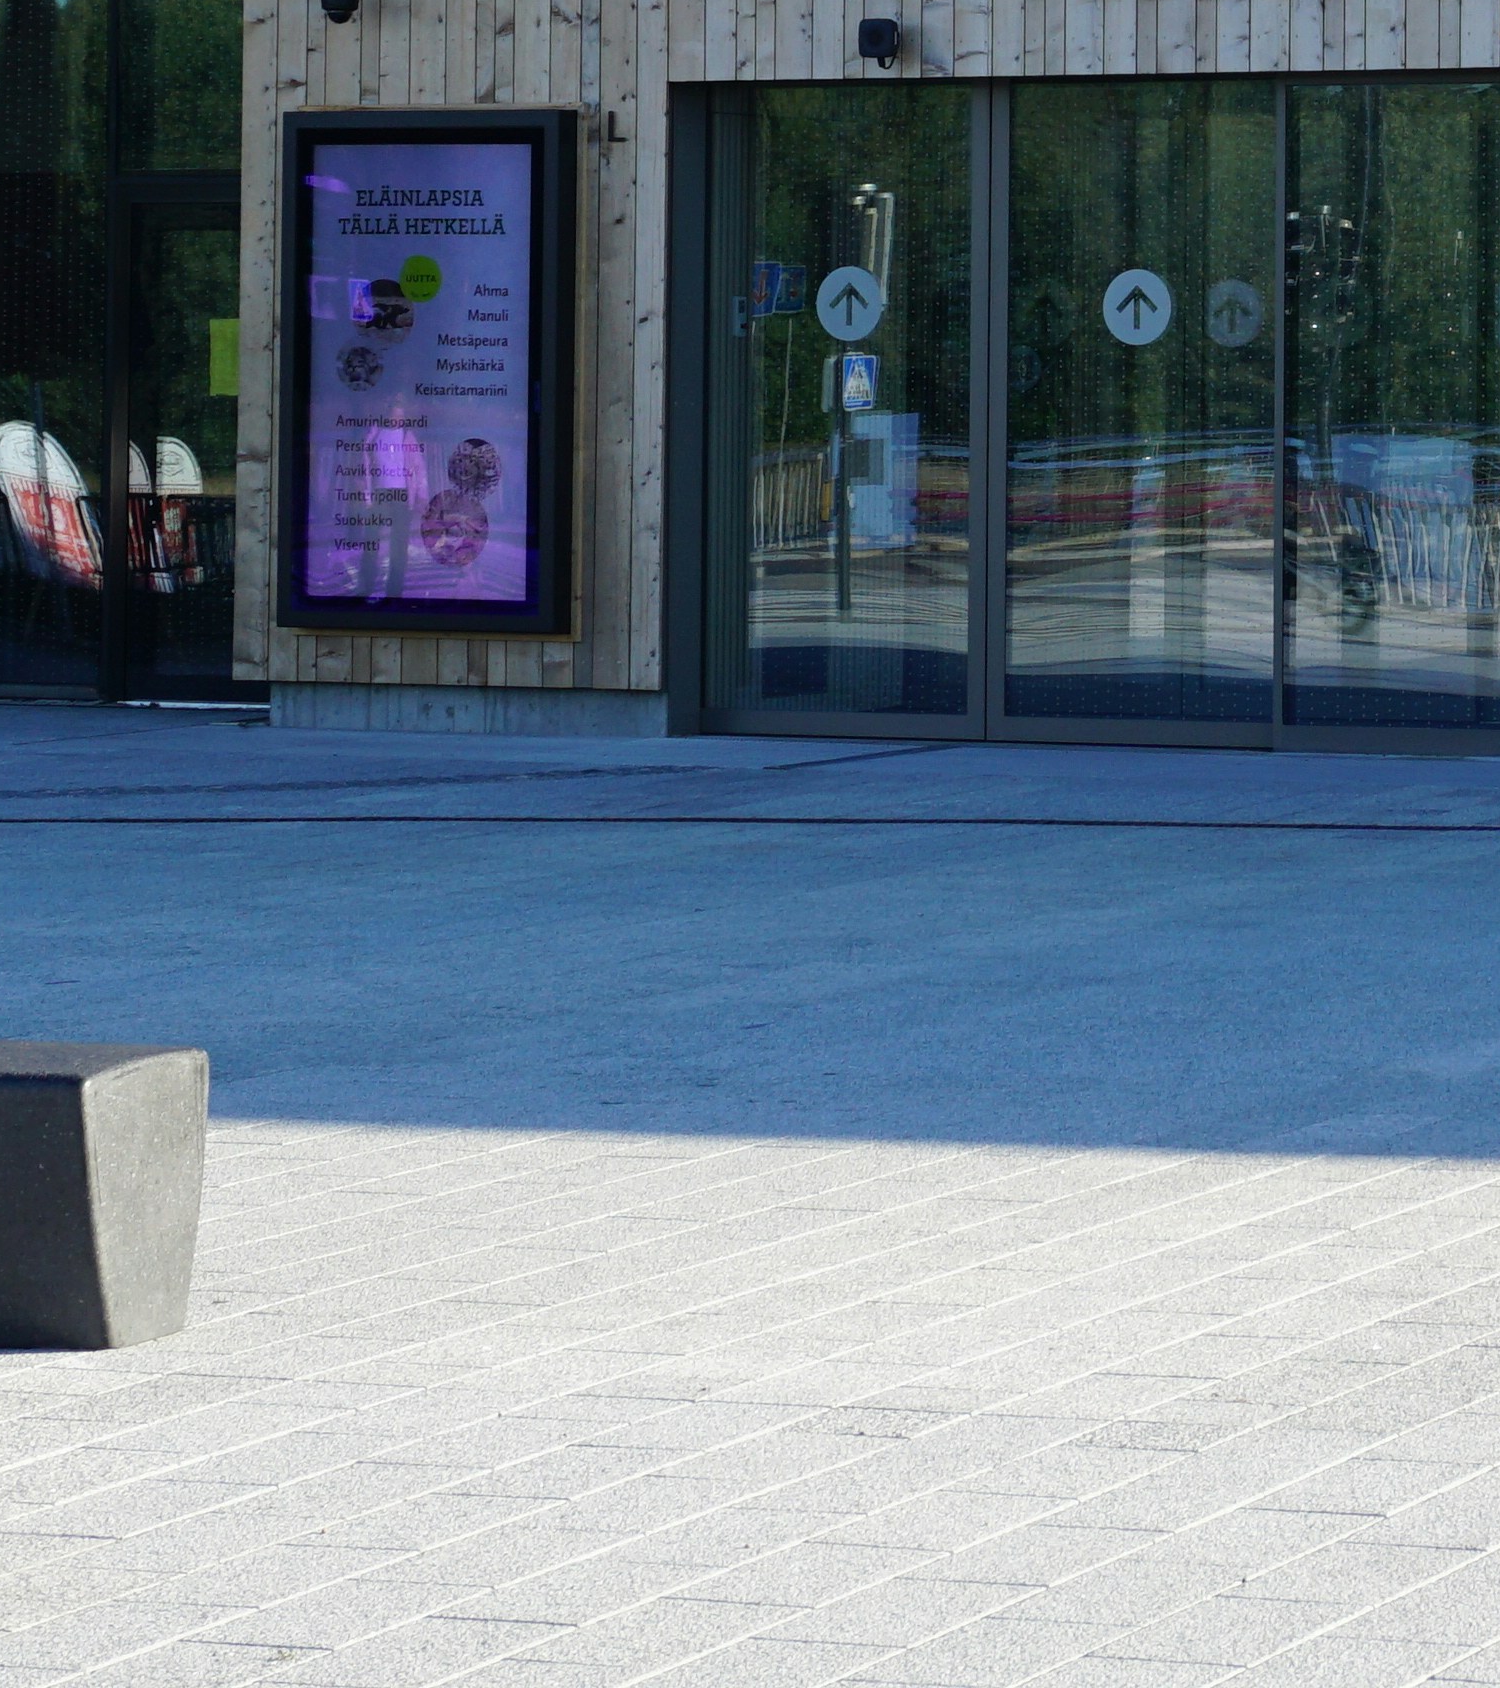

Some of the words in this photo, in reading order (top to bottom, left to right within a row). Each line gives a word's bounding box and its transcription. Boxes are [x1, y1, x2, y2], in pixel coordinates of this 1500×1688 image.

[356, 186, 484, 206] ELÄINLAPSIA
[339, 214, 400, 234] TÄLLÄ
[405, 214, 506, 235] HETKELLÄ
[406, 274, 437, 283] UUTTA
[473, 284, 508, 296] Ahma
[468, 309, 508, 321] Manuli
[438, 334, 508, 349] Metsäpeura
[437, 358, 504, 374] Myskihärkä
[415, 383, 507, 396] Keisaritamariini
[336, 415, 427, 430] Amurinleopardi
[336, 489, 408, 503] Tunturipöllö
[335, 514, 393, 527] Suokukko
[335, 539, 380, 551] Visentti
